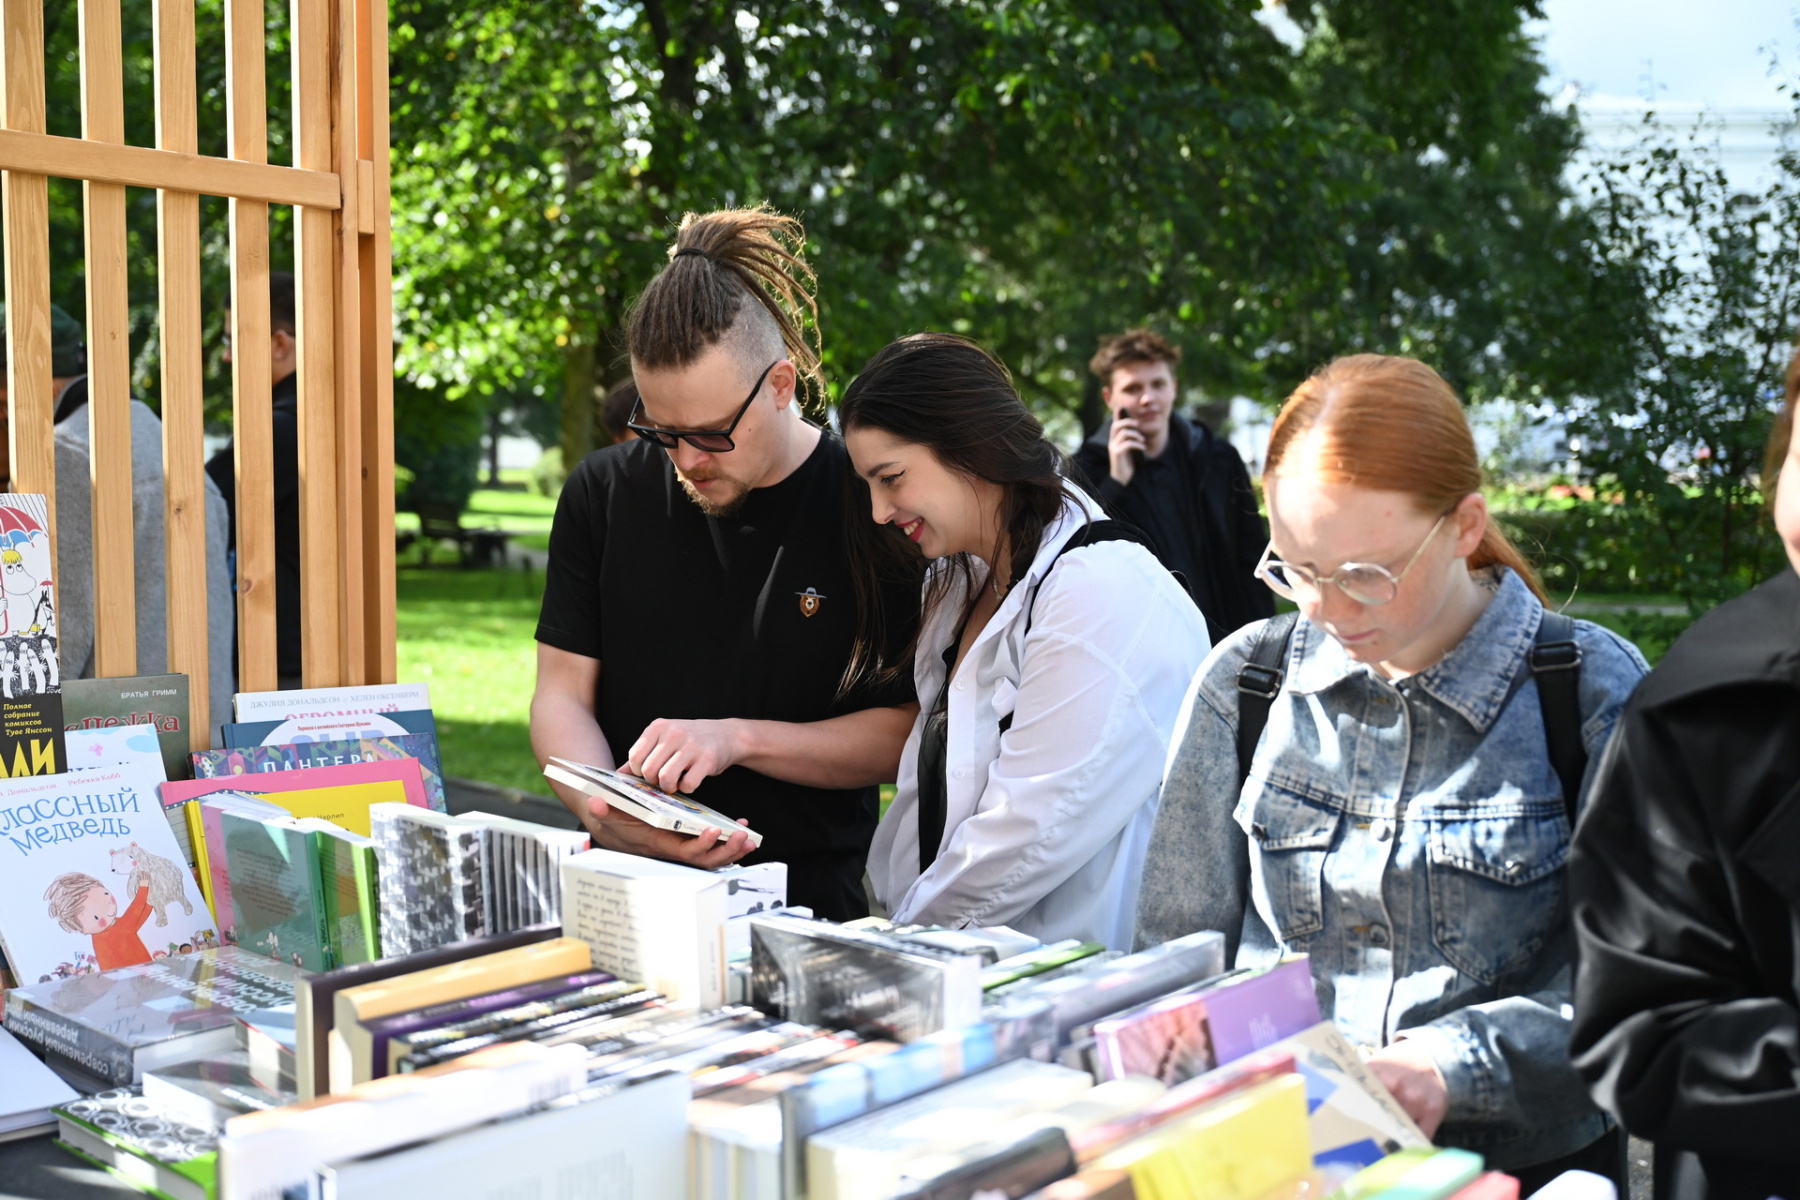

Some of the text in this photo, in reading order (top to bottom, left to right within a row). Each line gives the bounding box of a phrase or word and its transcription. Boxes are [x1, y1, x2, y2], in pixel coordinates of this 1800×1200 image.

[121, 688, 177, 699] БРАТЬЯ ГРИММ
[3, 703, 32, 711] Полное
[250, 700, 286, 709] ДЖУЛИЯ
[4, 711, 40, 720] собрание
[5, 727, 53, 737] Туве Янссон
[68, 772, 121, 786] Ребекка Кобб
[7, 784, 57, 796] Дональдсон
[0, 787, 140, 836] лассный
[9, 1019, 109, 1076] современный русский
